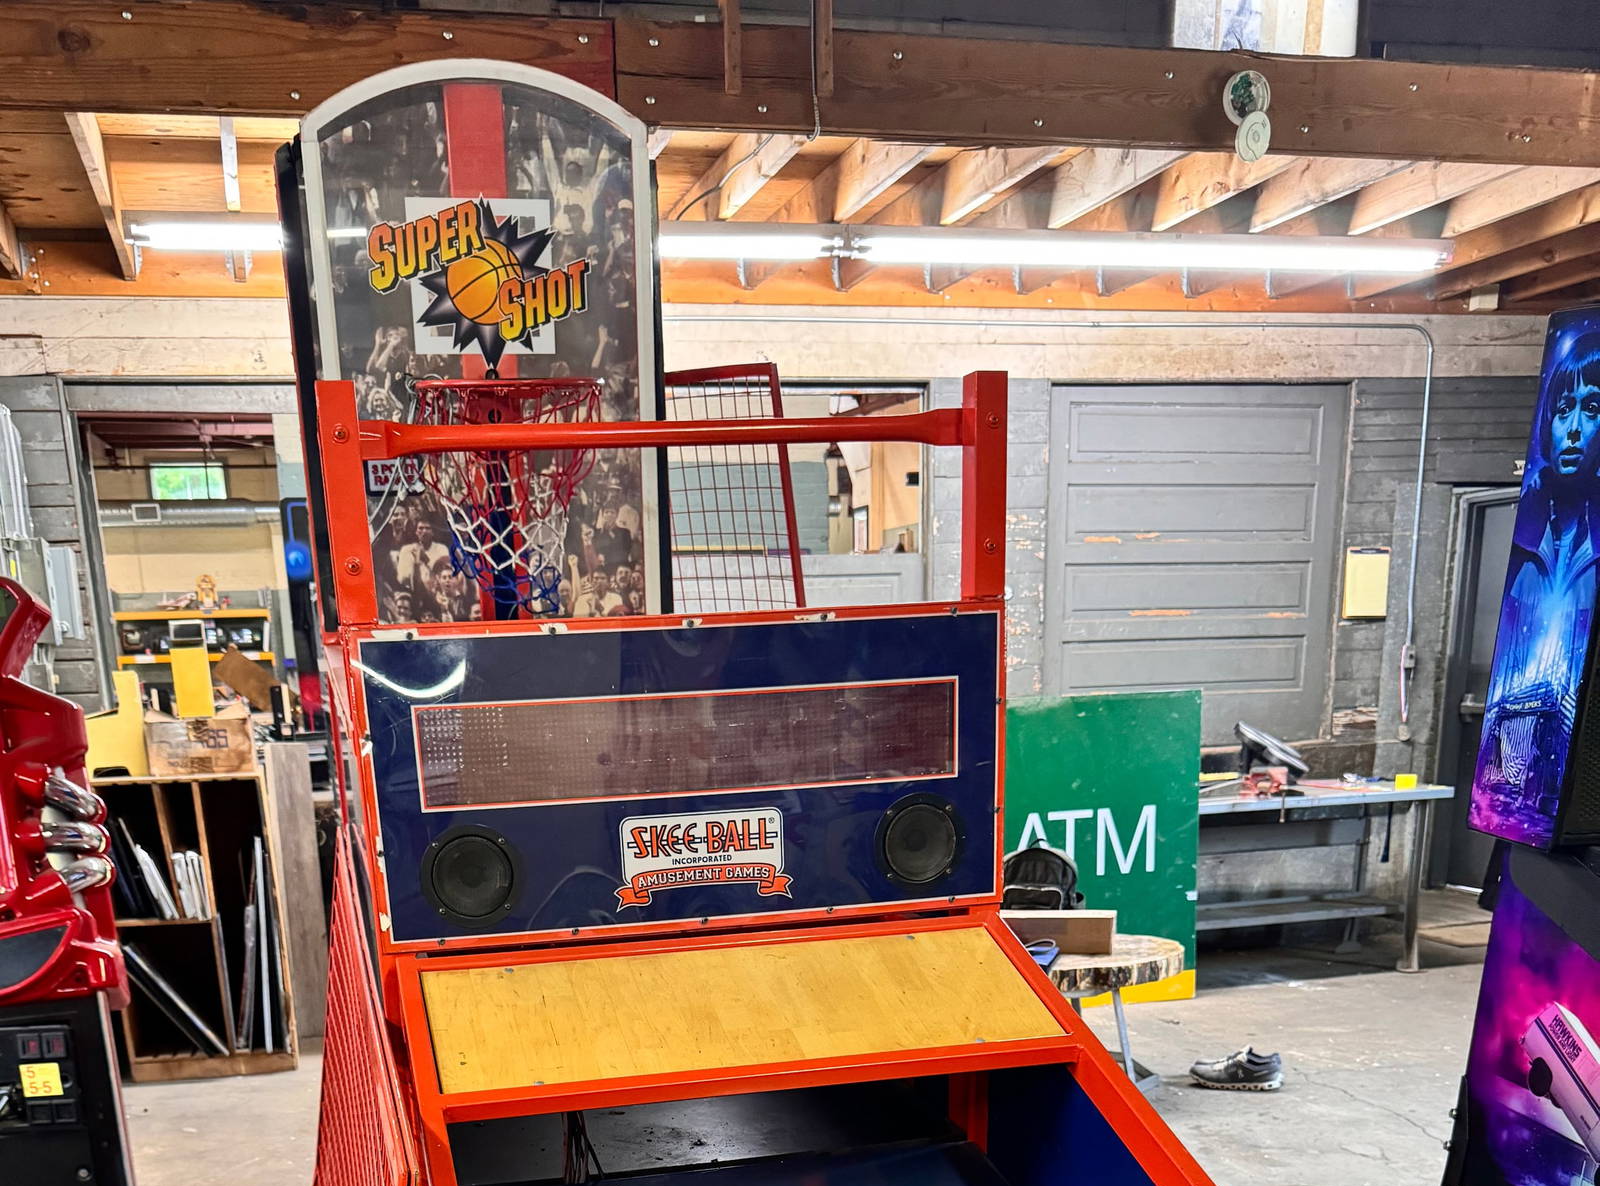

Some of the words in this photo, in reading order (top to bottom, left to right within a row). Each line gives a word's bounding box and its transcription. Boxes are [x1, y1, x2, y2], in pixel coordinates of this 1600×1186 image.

[368, 199, 486, 294] SUPER
[498, 258, 591, 342] SHOT
[671, 854, 733, 866] INCORPORATED
[1017, 804, 1157, 876] ATM
[637, 867, 722, 888] AMUSEMENT
[725, 866, 770, 878] GAMES
[1551, 1014, 1582, 1057] HAWKINS
[26, 1066, 36, 1079] 5
